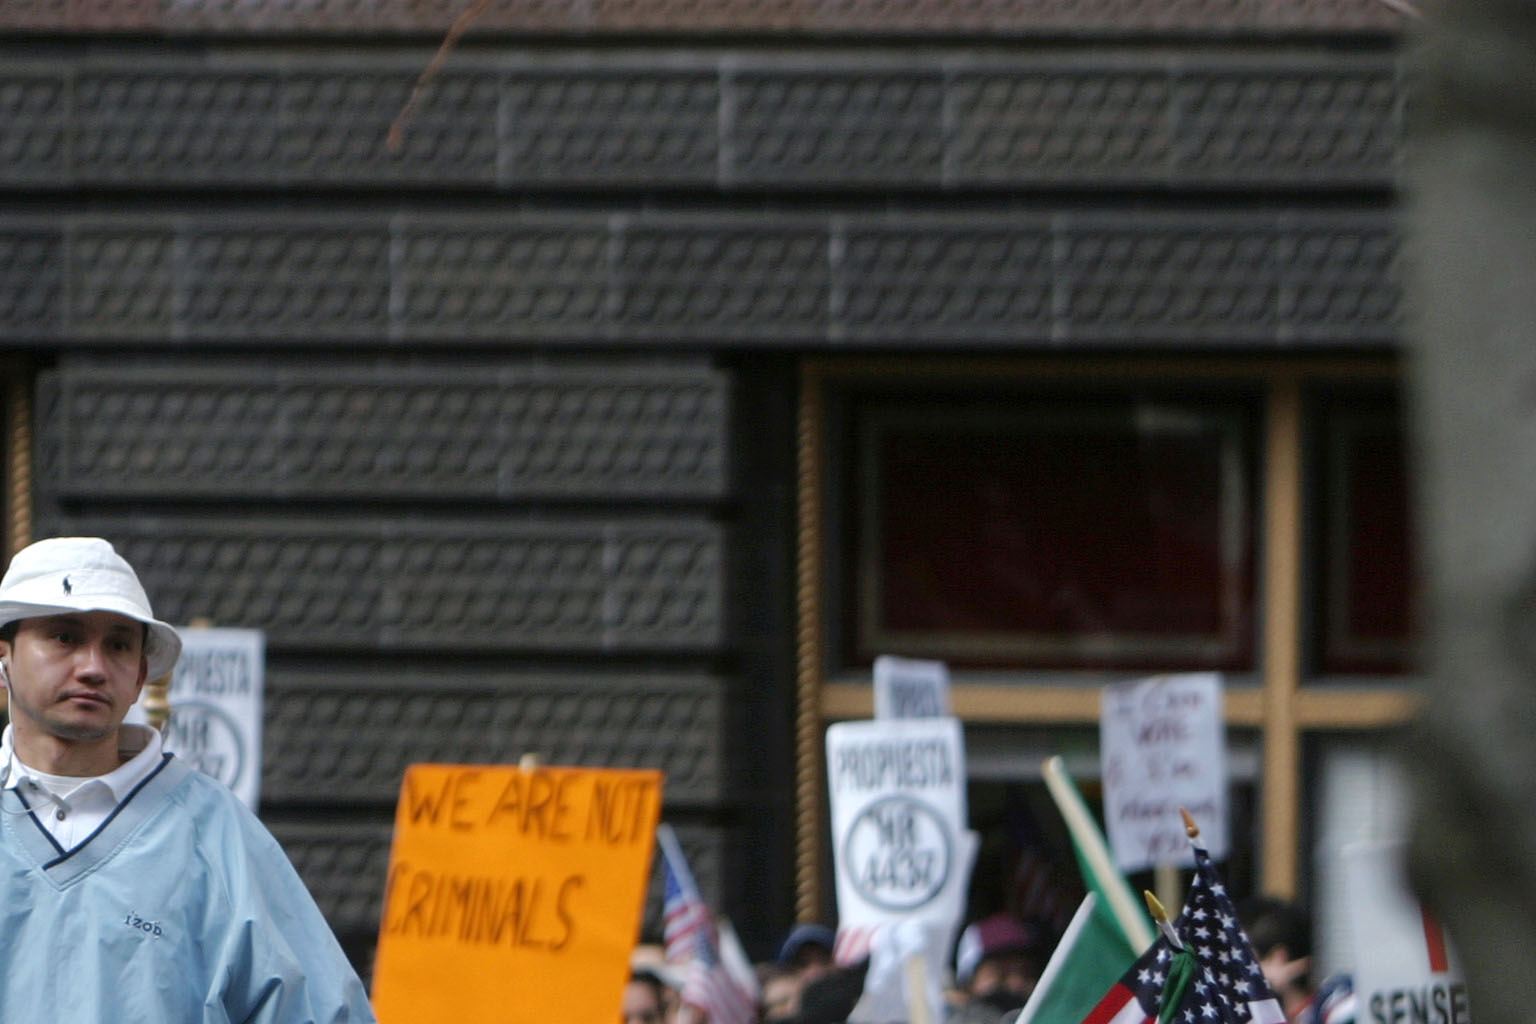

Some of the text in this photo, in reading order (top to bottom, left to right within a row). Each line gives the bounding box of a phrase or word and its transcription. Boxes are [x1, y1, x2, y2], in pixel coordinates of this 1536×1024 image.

[404, 770, 658, 846] WE ARE NOT
[125, 914, 163, 936] IZOD
[382, 858, 586, 952] CRIMINALS
